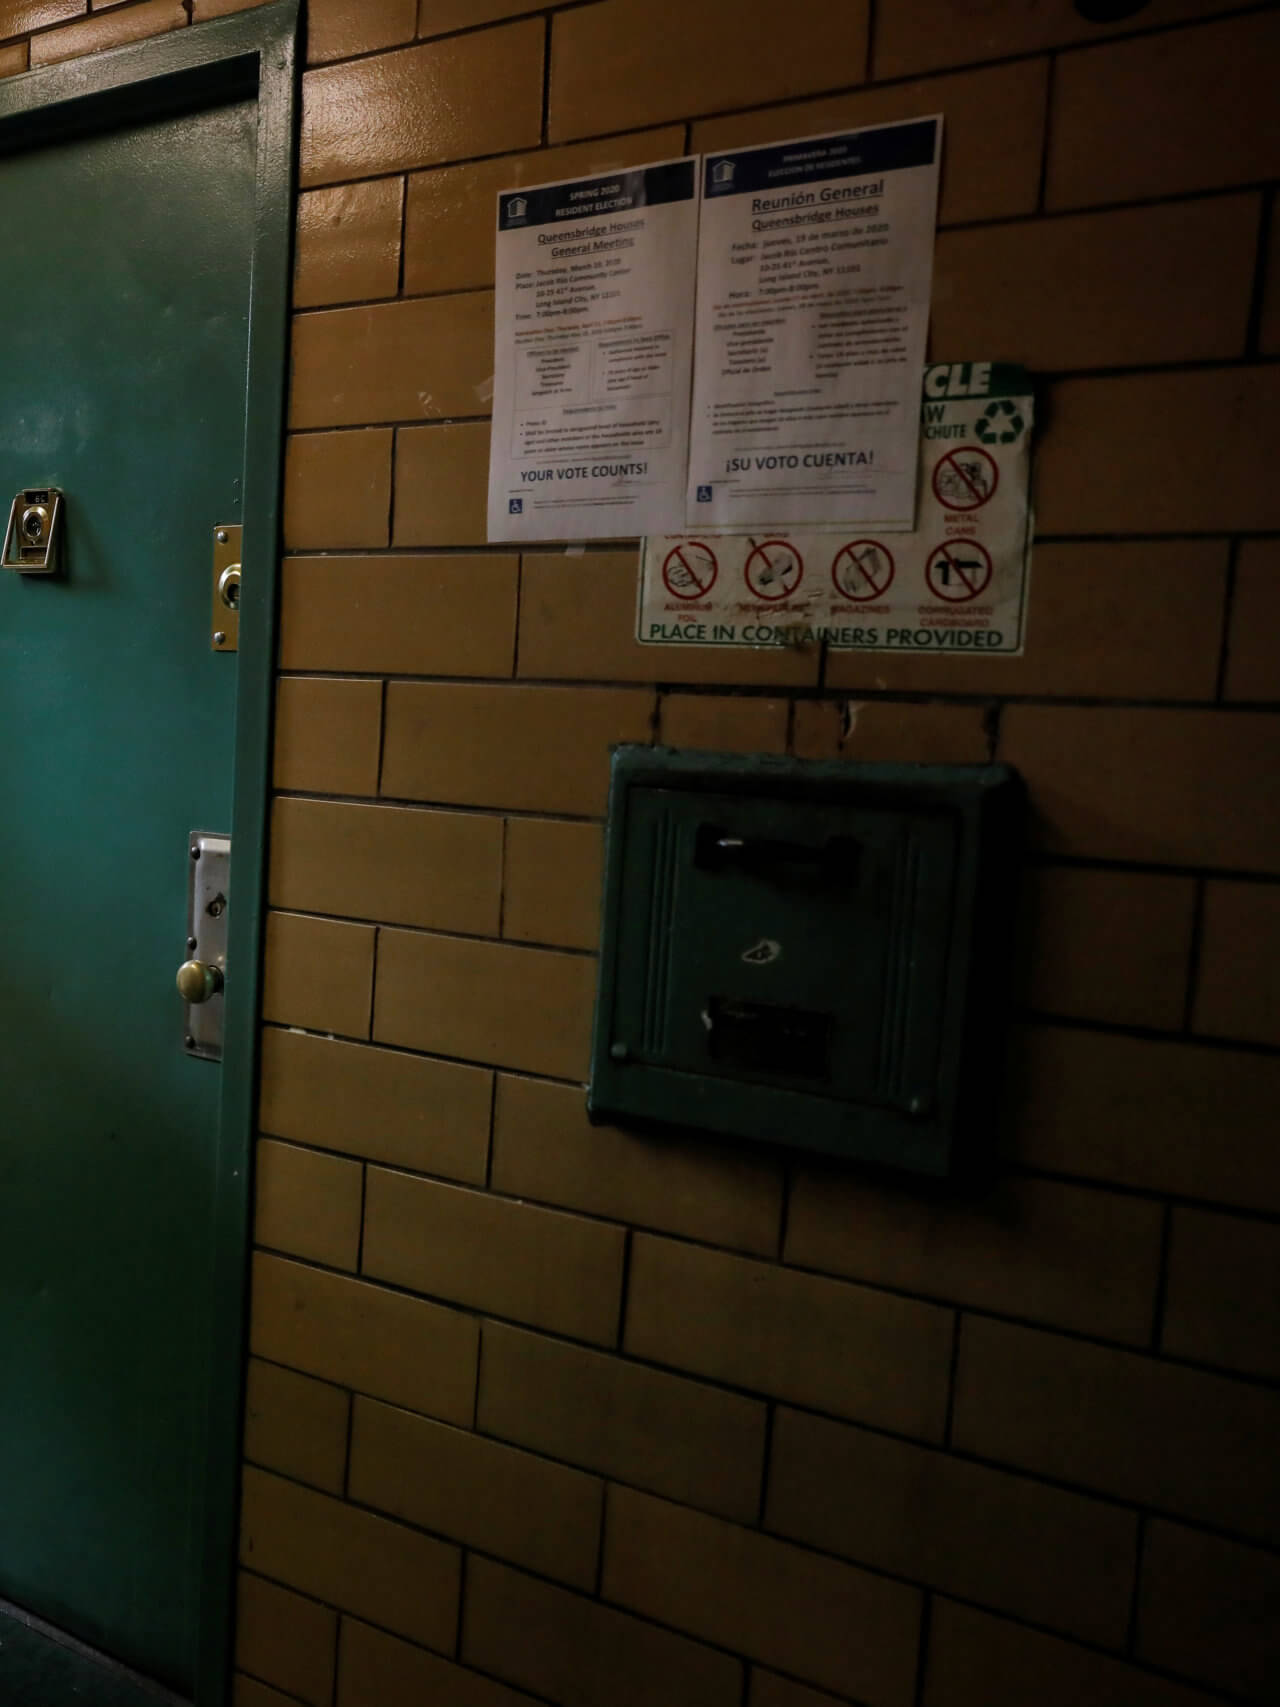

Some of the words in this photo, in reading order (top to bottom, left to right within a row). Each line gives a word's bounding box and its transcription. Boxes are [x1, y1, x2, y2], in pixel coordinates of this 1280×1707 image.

[752, 192, 815, 213] Reunión
[820, 179, 885, 202] General
[752, 210, 832, 231] Queensbridge
[835, 204, 880, 219] Houses
[537, 223, 608, 244] Queensbridge
[551, 241, 591, 257] General
[593, 237, 635, 253] Meeting
[924, 362, 992, 399] CLE
[926, 423, 968, 441] CHUTE
[521, 469, 554, 482] YOUR
[556, 466, 588, 479] VOTE
[591, 462, 648, 478] COUNTS!
[726, 457, 751, 473] ¡SU
[755, 454, 799, 470] VOTO
[802, 449, 874, 467] CUENTA!
[649, 623, 707, 640] PLACE
[712, 625, 736, 641] IN
[741, 625, 878, 644] CONTAINERS
[885, 628, 1004, 648] PROVIDED
